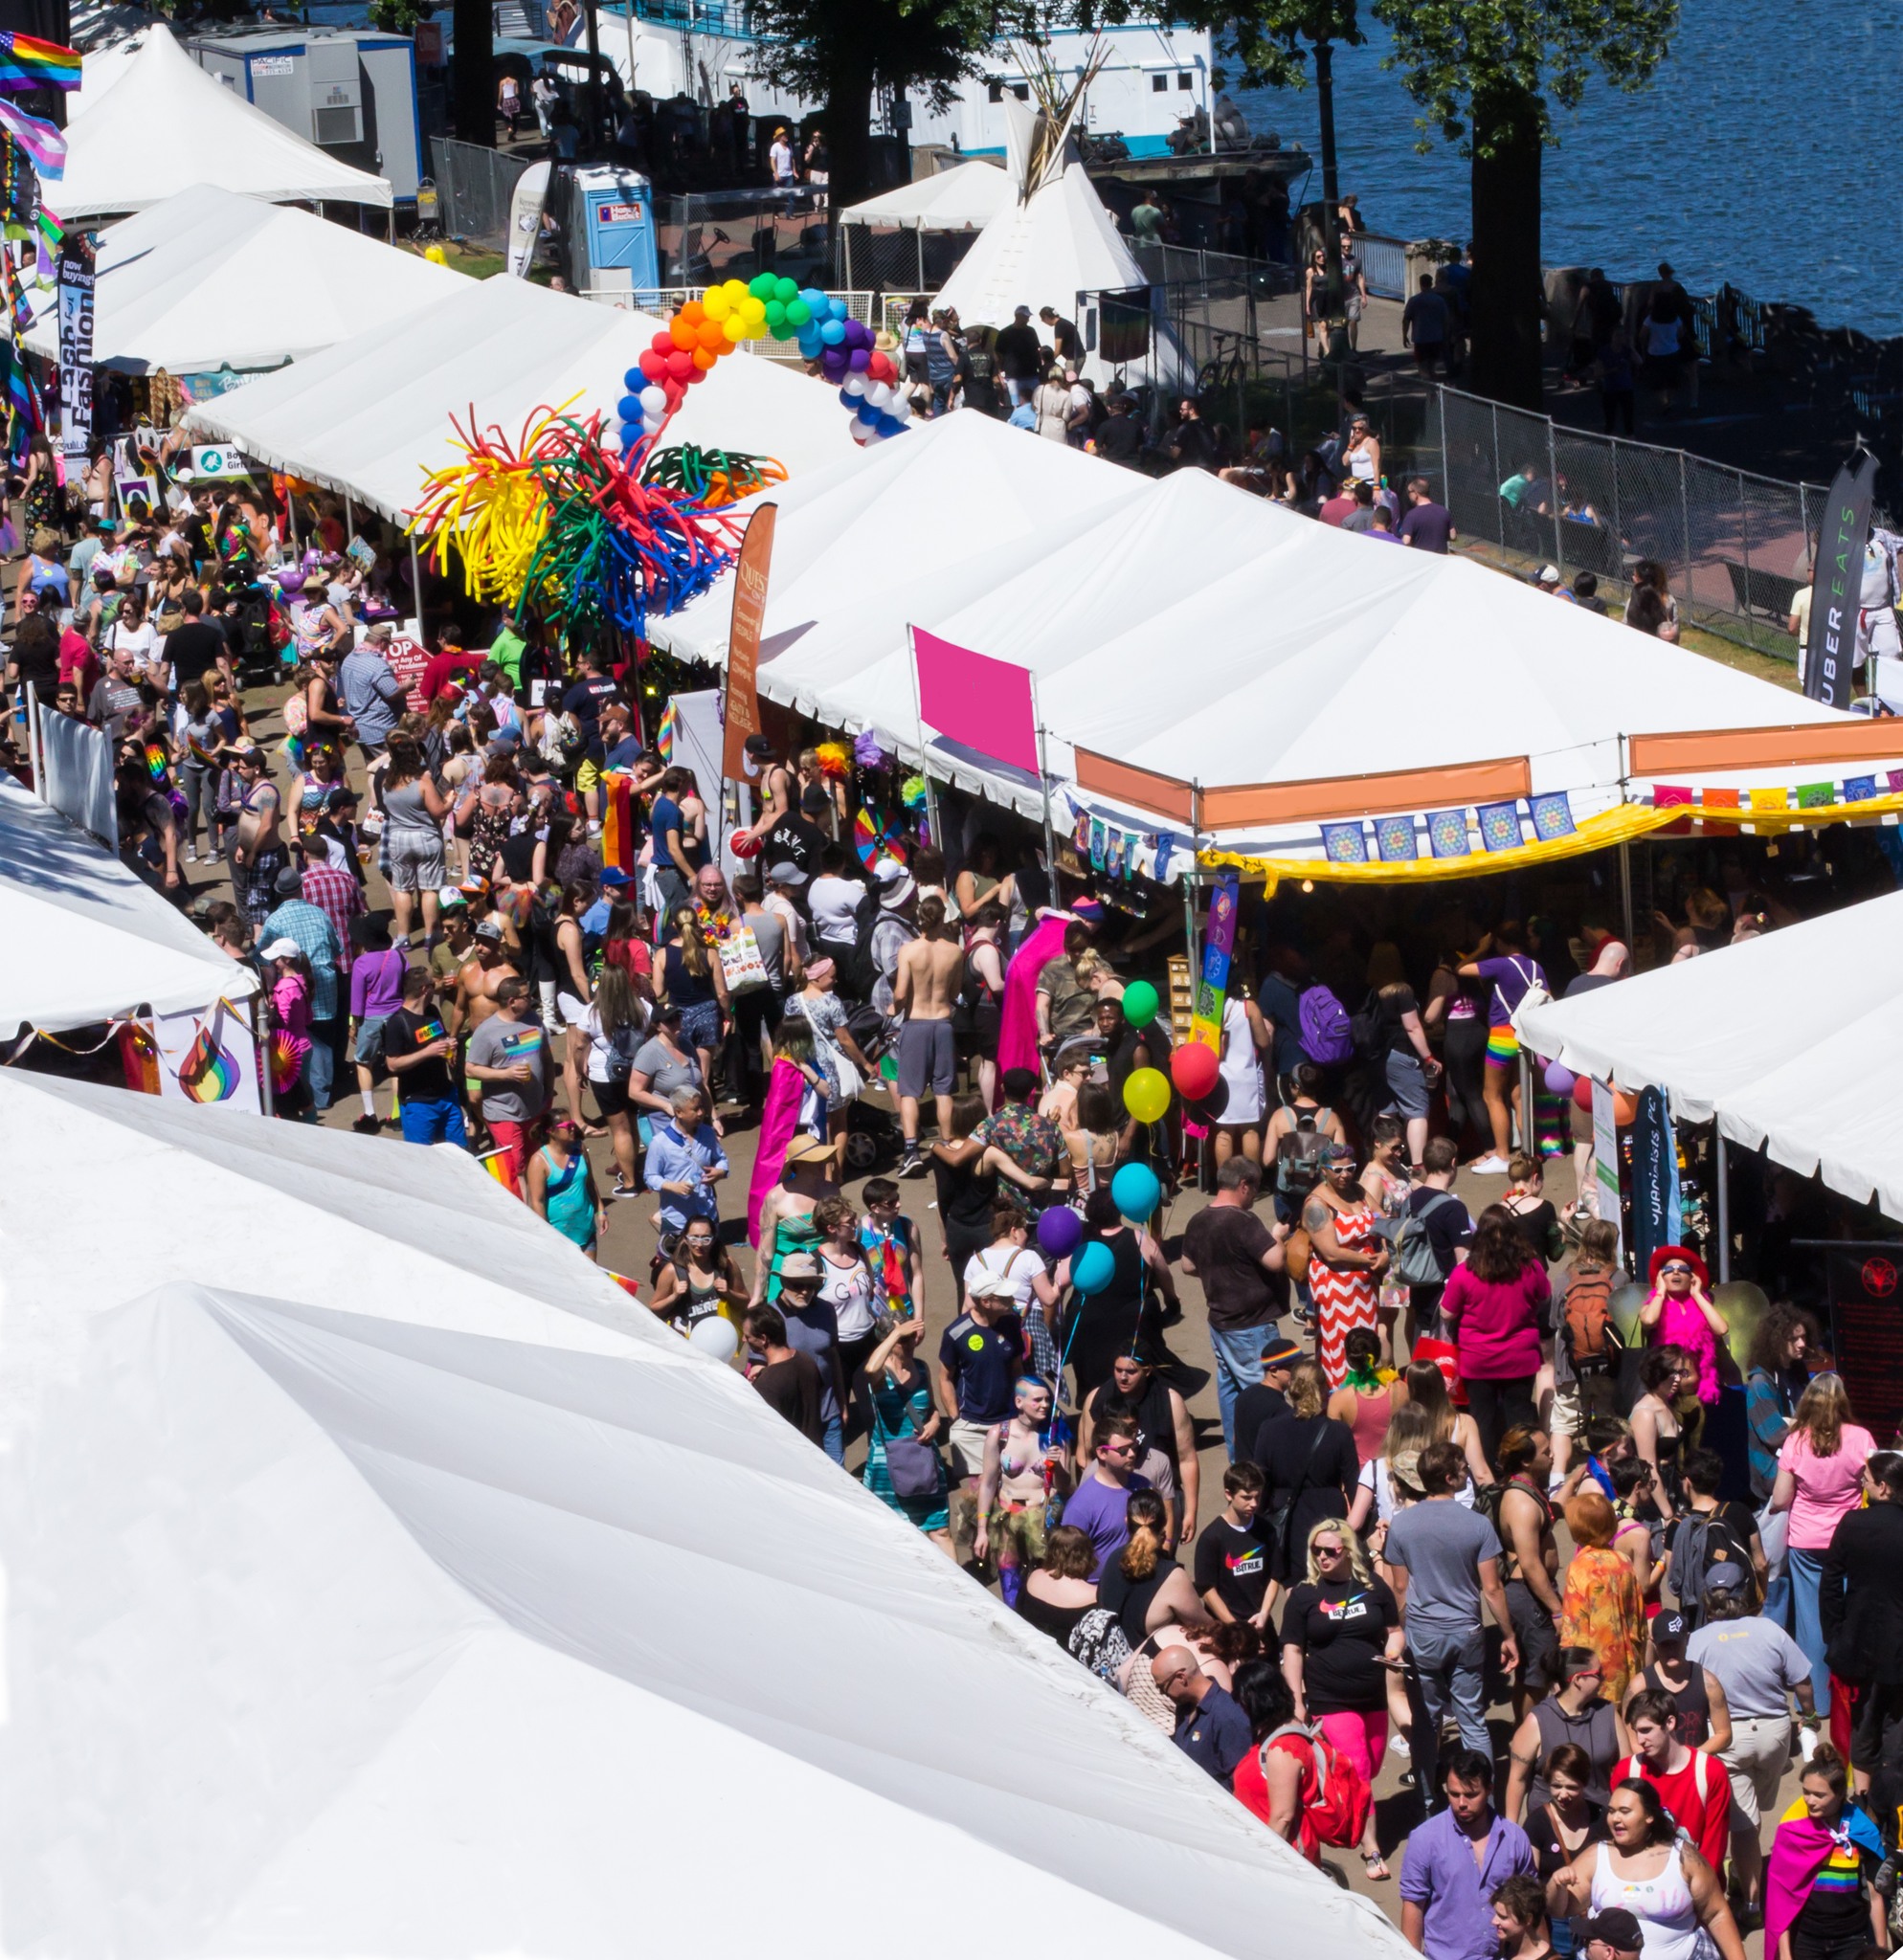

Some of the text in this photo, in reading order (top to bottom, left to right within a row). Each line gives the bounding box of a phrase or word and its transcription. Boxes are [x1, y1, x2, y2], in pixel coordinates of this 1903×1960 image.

[62, 268, 95, 286] buying!
[63, 259, 82, 271] now
[72, 290, 95, 433] Fashion
[1821, 505, 1855, 706] UBER EATS
[1647, 1095, 1657, 1125] PC
